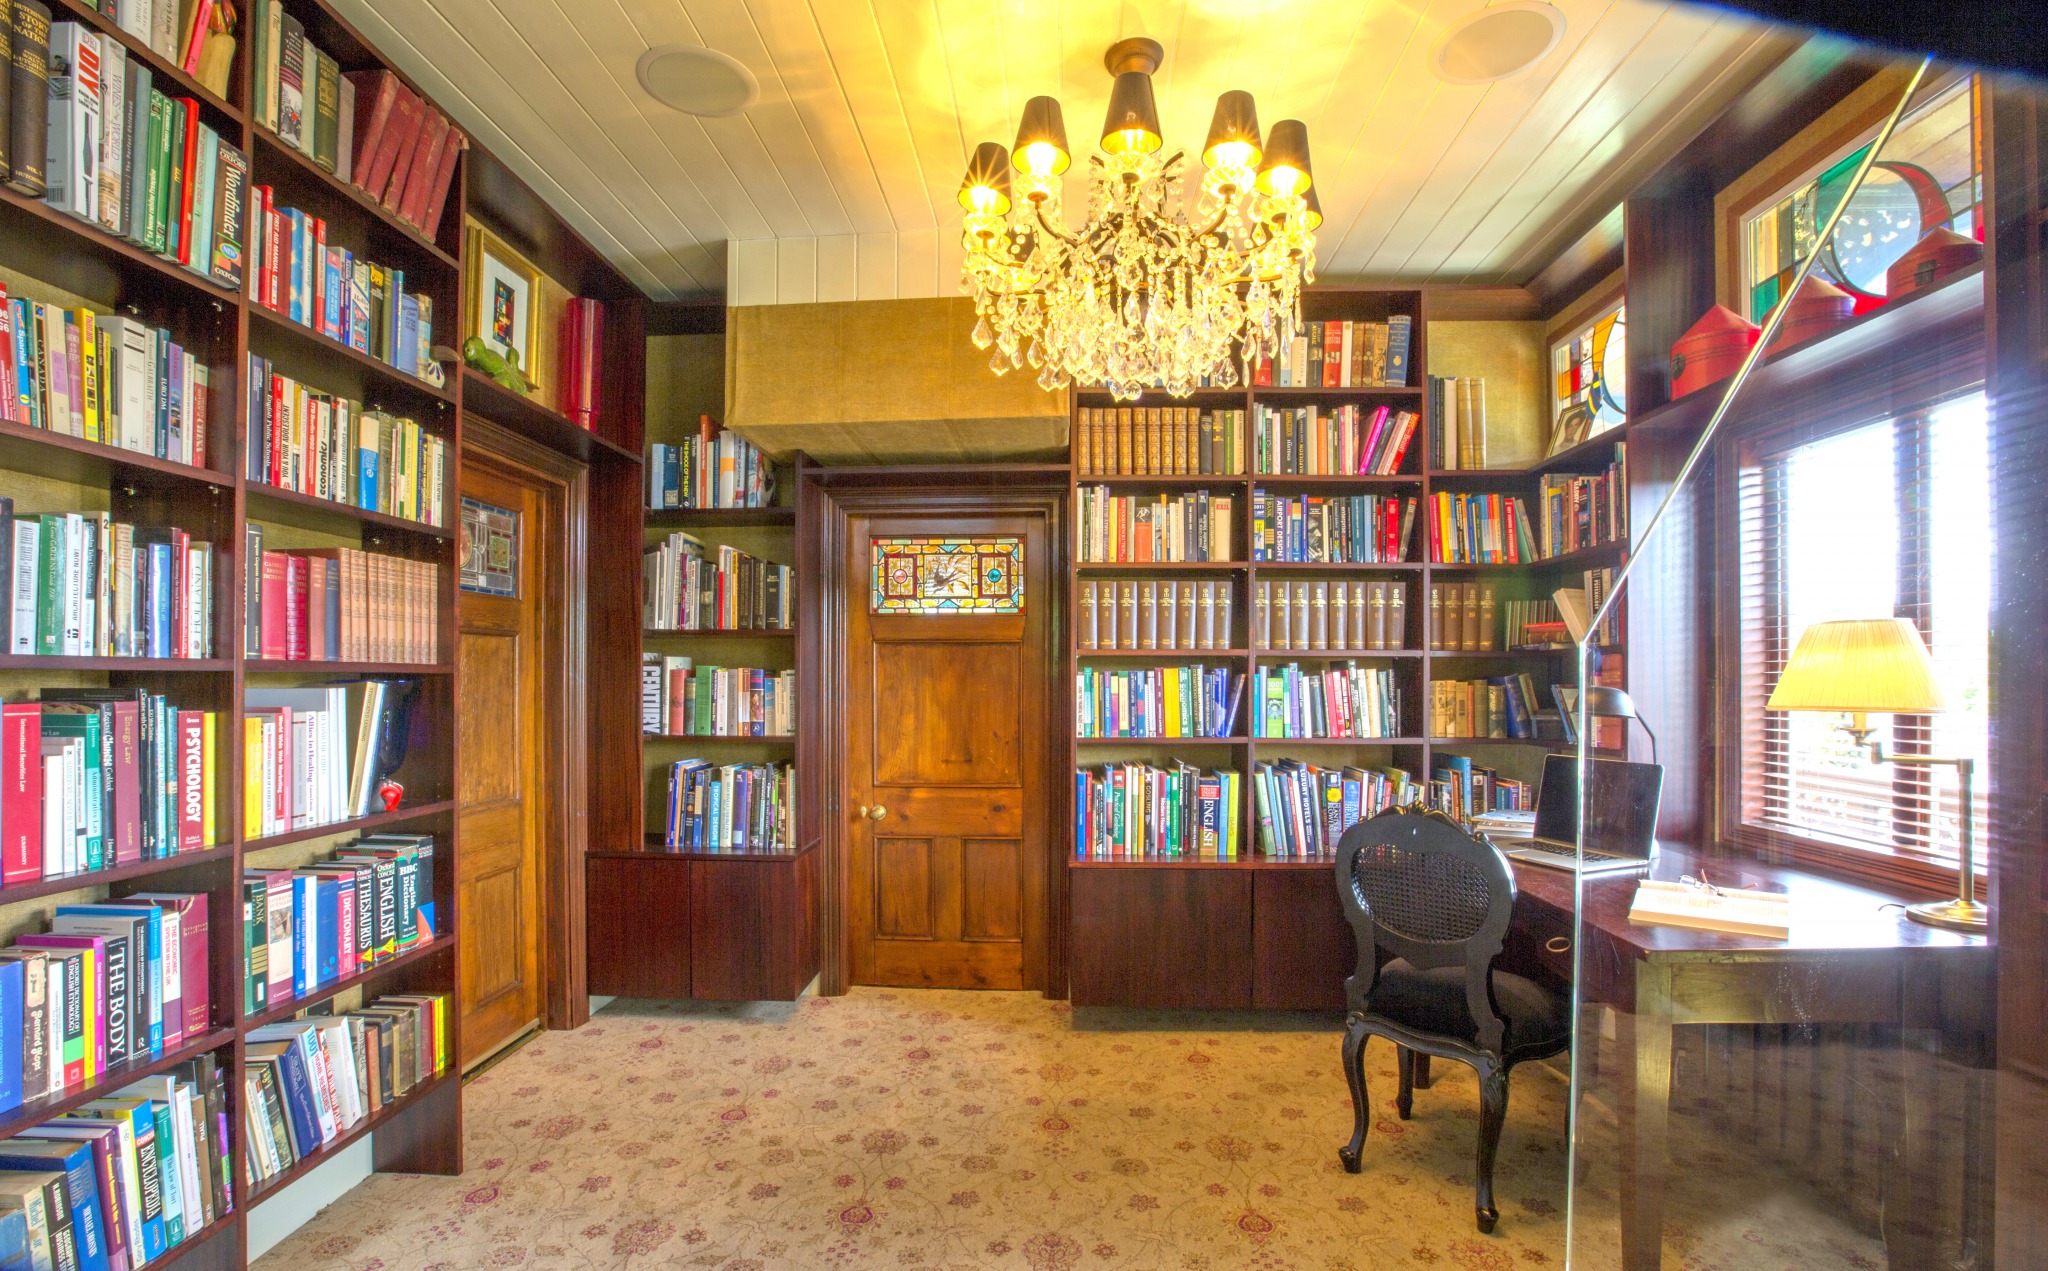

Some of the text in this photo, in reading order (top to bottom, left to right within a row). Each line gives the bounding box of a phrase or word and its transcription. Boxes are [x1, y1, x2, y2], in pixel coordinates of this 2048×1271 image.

[19, 11, 48, 33] STORY
[79, 42, 99, 99] DIY
[219, 150, 247, 172] OXFORD
[224, 165, 241, 240] Wordfinder
[222, 245, 236, 258] NEW
[214, 267, 241, 285] OXFORD
[17, 330, 26, 366] Spanish
[38, 339, 46, 392] CANADA
[161, 398, 167, 410] DM
[123, 716, 132, 744] Energy
[186, 727, 201, 822] PSYCHOLOGY
[1300, 769, 1309, 796] LUXURY
[1203, 800, 1214, 847] ENGLISH
[377, 862, 395, 873] Oxford
[400, 864, 418, 876] BBC
[343, 897, 352, 954] DICTIONARY
[360, 880, 371, 949] THESAURUS
[380, 876, 394, 940] ENGLISH
[109, 947, 127, 1055] THE BODY
[31, 1010, 44, 1071] Bernard Kops
[306, 1030, 318, 1057] 1001
[314, 1054, 324, 1076] HOME
[318, 1078, 330, 1114] REMEDIES
[140, 1142, 161, 1219] ENCYCLOPEDIA
[55, 1231, 65, 1262] BUSINESS
[63, 1229, 75, 1267] GEOGRAPHY
[83, 1205, 97, 1257] MICHAEL DROSNIN
